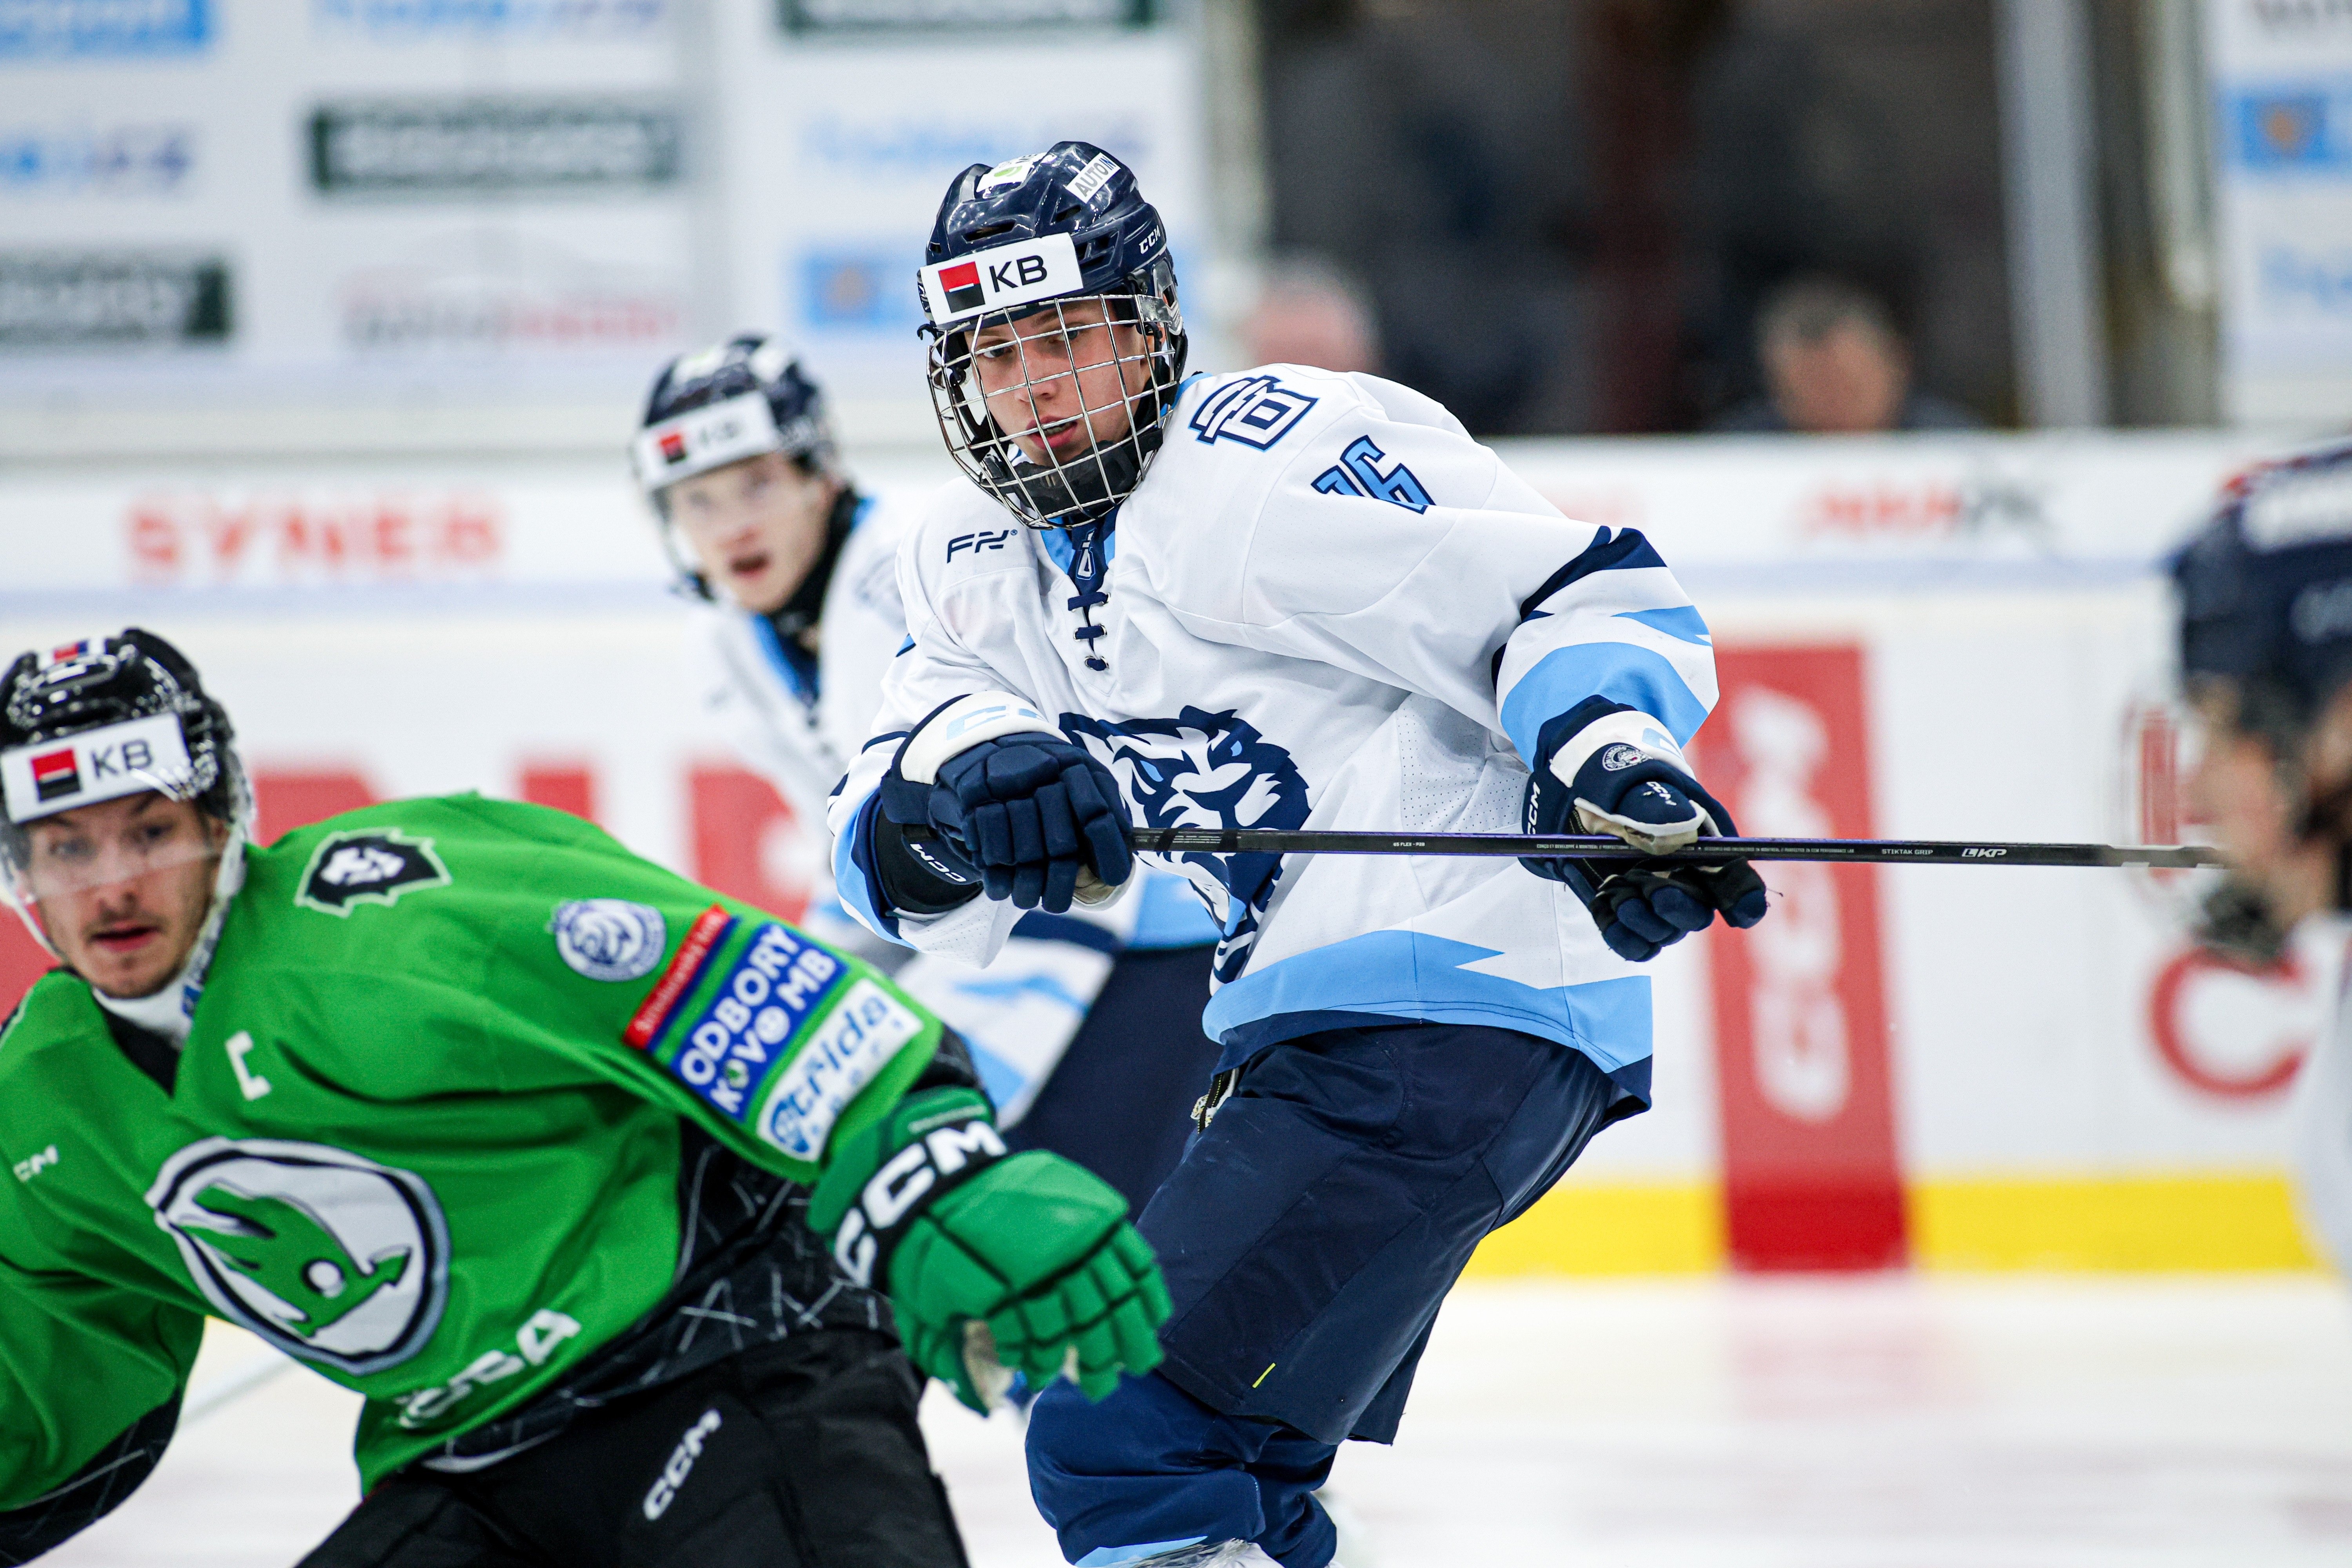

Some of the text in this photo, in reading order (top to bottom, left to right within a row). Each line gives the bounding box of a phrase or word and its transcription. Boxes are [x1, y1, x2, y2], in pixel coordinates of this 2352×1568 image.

[989, 255, 1047, 293] KB
[1138, 224, 1161, 254] CCM
[90, 739, 153, 780] KB
[910, 844, 967, 882] CCM
[680, 924, 800, 1085] ODBORY
[710, 948, 836, 1114] KOVO MB
[225, 1031, 271, 1101] C
[833, 1119, 1008, 1289] CCM
[643, 1409, 722, 1520] CCM
